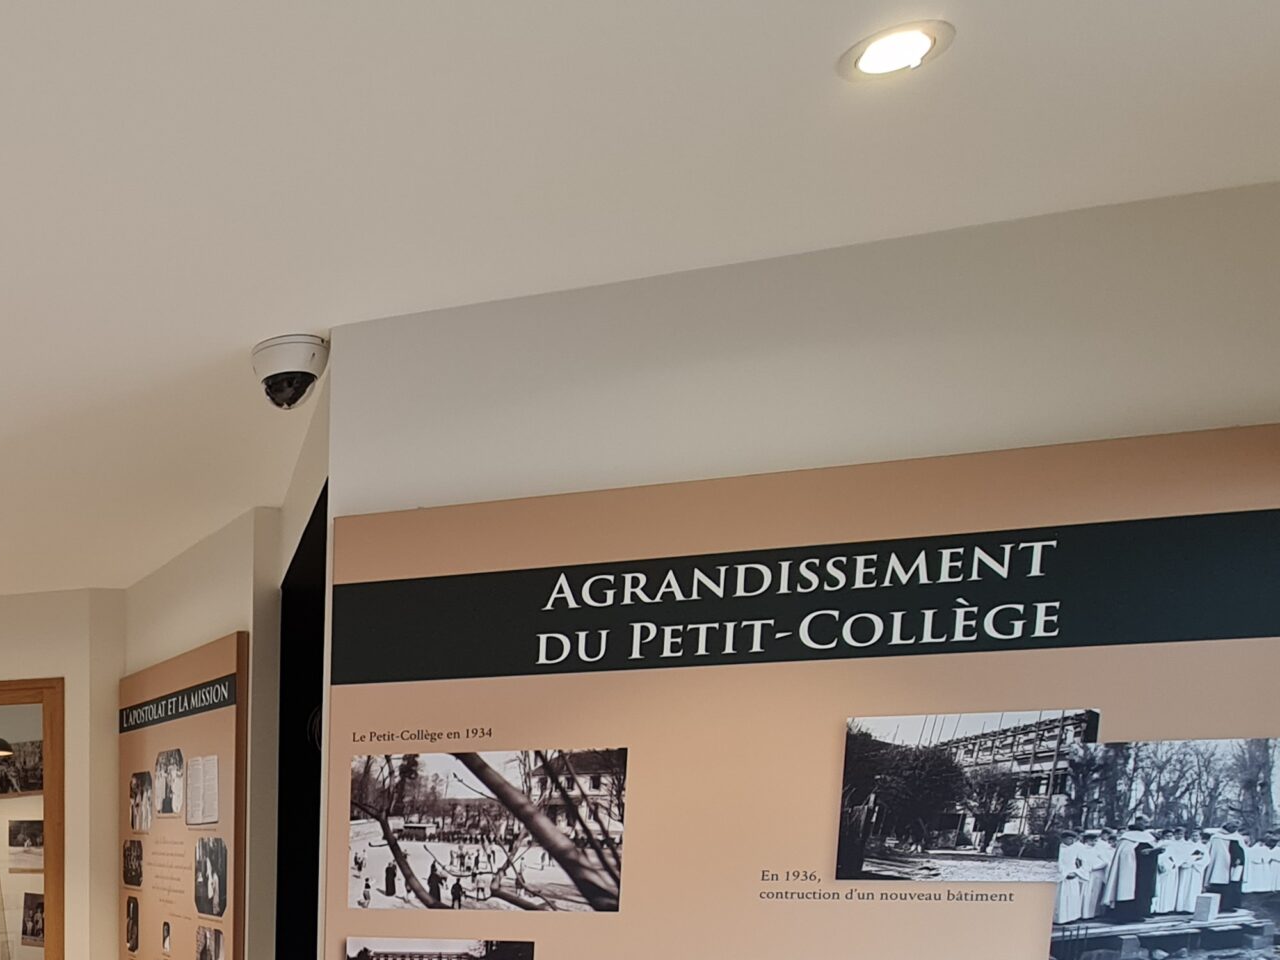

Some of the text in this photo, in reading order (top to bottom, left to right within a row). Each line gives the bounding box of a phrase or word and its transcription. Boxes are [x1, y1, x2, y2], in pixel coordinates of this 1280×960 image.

[541, 540, 1058, 612] AGRANDISSEMENT
[536, 597, 1061, 665] DU PETIT-COLLÈGE
[123, 682, 228, 727] L'APOSTOLAT ET LA MISSION
[352, 728, 492, 743] Le Petit-Collège en 1934
[760, 870, 821, 883] En 1936,
[759, 888, 1014, 902] contruction d'un nouveau bâtiment
